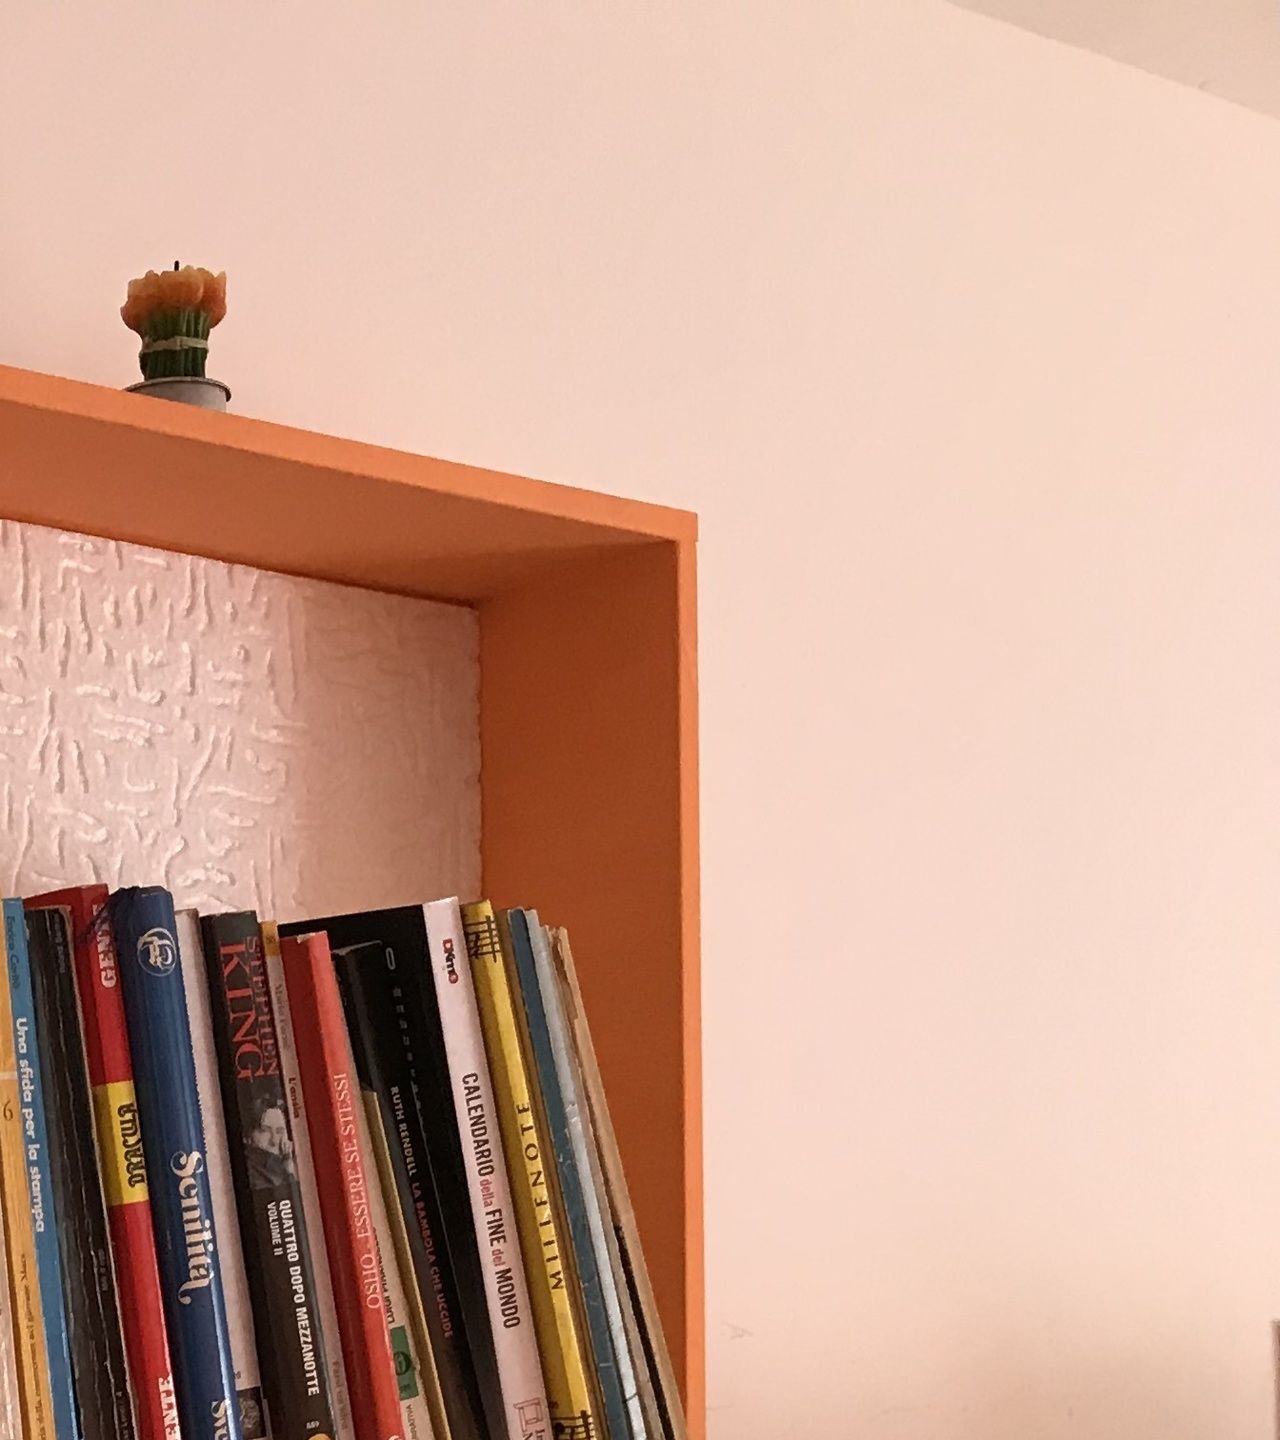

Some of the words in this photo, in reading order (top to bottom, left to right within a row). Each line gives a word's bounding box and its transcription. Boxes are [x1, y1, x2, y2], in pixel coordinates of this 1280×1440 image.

[220, 941, 271, 1083] KING
[245, 934, 280, 1076] STEPHEN
[15, 1016, 28, 1054] Una
[19, 1058, 34, 1103] sfida
[390, 1085, 405, 1121] RUTH
[3, 1099, 14, 1122] 6
[22, 1107, 35, 1140] per
[333, 1072, 357, 1137] STESSI
[462, 1072, 496, 1178] CALENDARIO
[27, 1143, 40, 1160] la
[343, 1139, 361, 1166] SE
[397, 1122, 418, 1178] RENDELL
[30, 1162, 45, 1233] stampa
[346, 1168, 372, 1239] ESSERE
[411, 1182, 422, 1199] LA
[479, 1176, 496, 1208] della
[266, 1201, 282, 1247] VOLUME
[278, 1199, 300, 1262] QUATTRO
[414, 1200, 436, 1264] BAMBOLA
[484, 1207, 508, 1246] FINE
[429, 1265, 441, 1287] CHE
[491, 1247, 506, 1267] del
[288, 1264, 305, 1304] DOPO
[359, 1254, 382, 1310] OSHO
[495, 1267, 521, 1330] MONDO
[435, 1290, 454, 1339] UCCIDE
[295, 1305, 320, 1397] MEZZANOTTE
